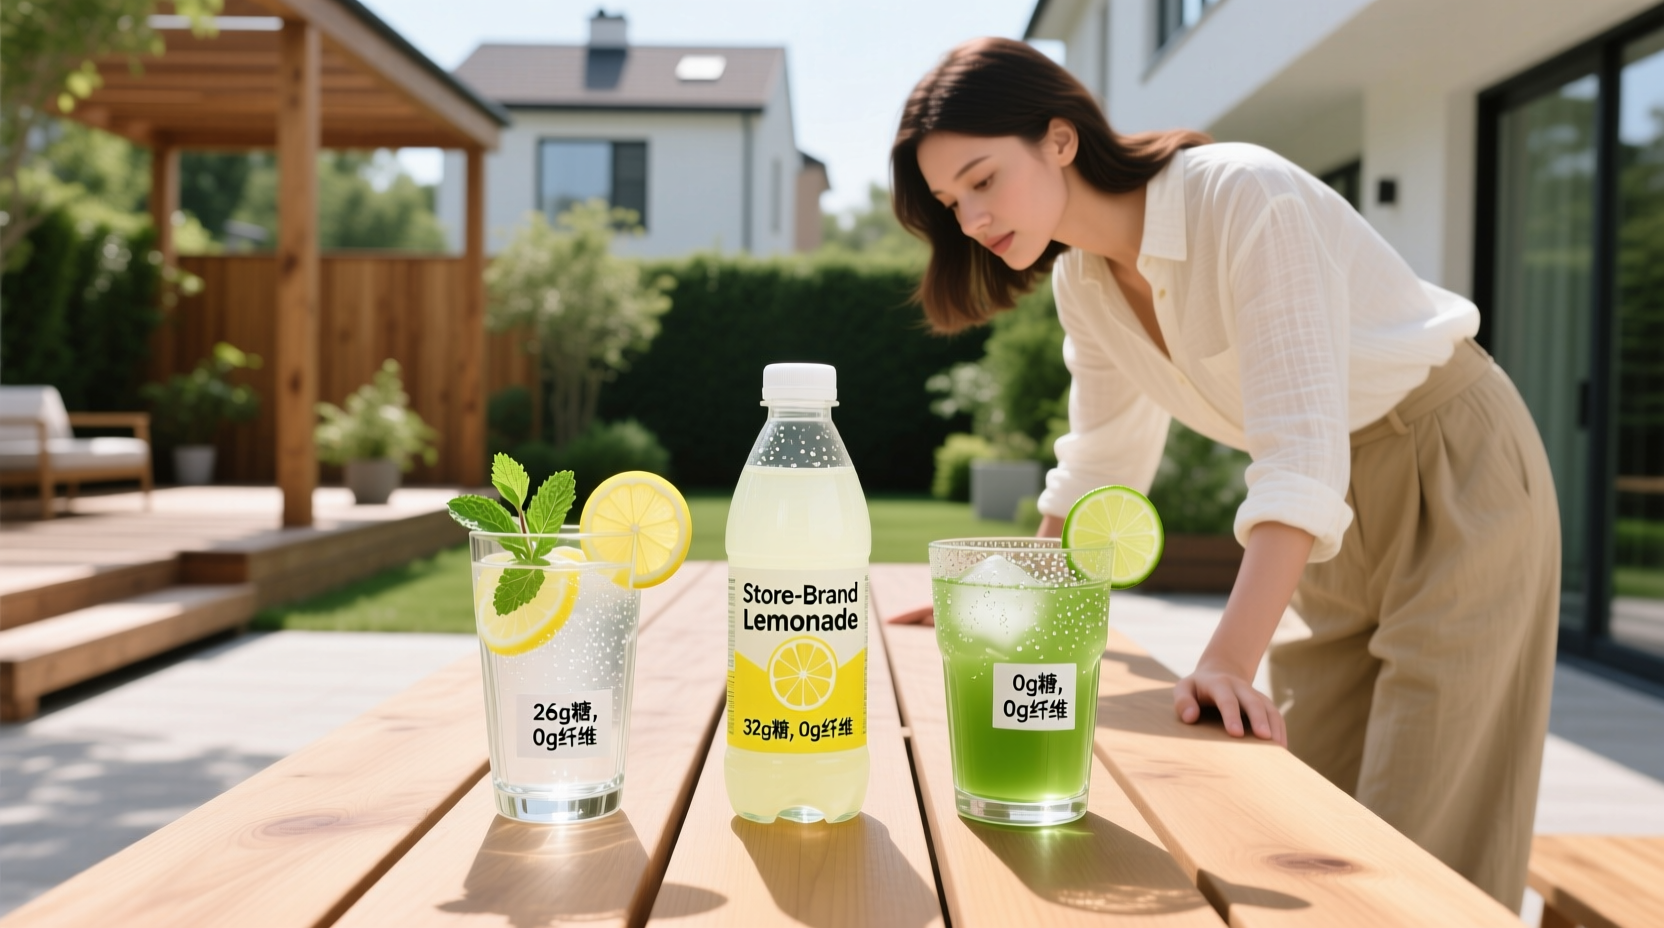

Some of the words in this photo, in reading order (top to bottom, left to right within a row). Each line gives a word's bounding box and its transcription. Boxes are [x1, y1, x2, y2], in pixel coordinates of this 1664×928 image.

[743, 581, 858, 605] Store-Brand
[743, 607, 858, 631] Lemonade
[533, 700, 598, 725] 26g糖,
[1003, 698, 1068, 723] 0g纤维
[532, 725, 597, 751] 0g纤维
